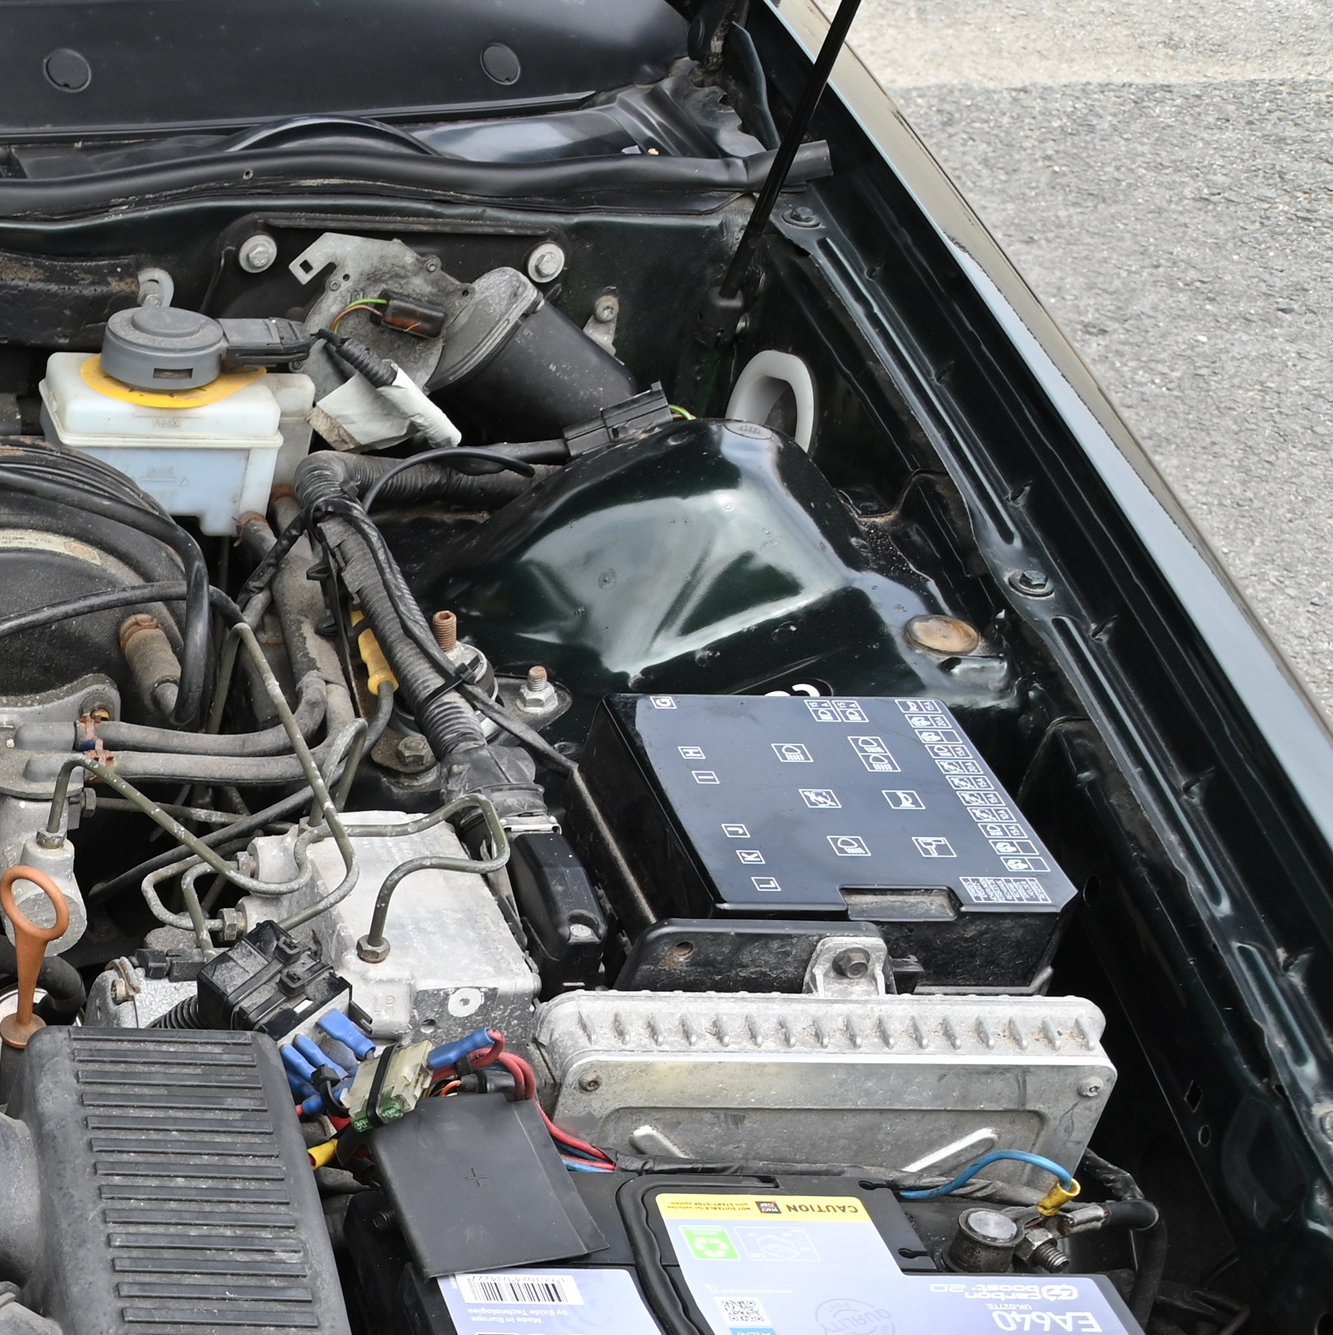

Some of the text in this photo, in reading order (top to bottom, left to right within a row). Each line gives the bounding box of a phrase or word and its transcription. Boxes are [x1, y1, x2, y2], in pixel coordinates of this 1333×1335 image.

[742, 852, 760, 861] K
[786, 1204, 858, 1214] CAUTION
[965, 1292, 1041, 1300] carbon
[468, 1308, 528, 1316] Technologies
[821, 1309, 891, 1334] QUALITY
[992, 1311, 1102, 1332] EA640
